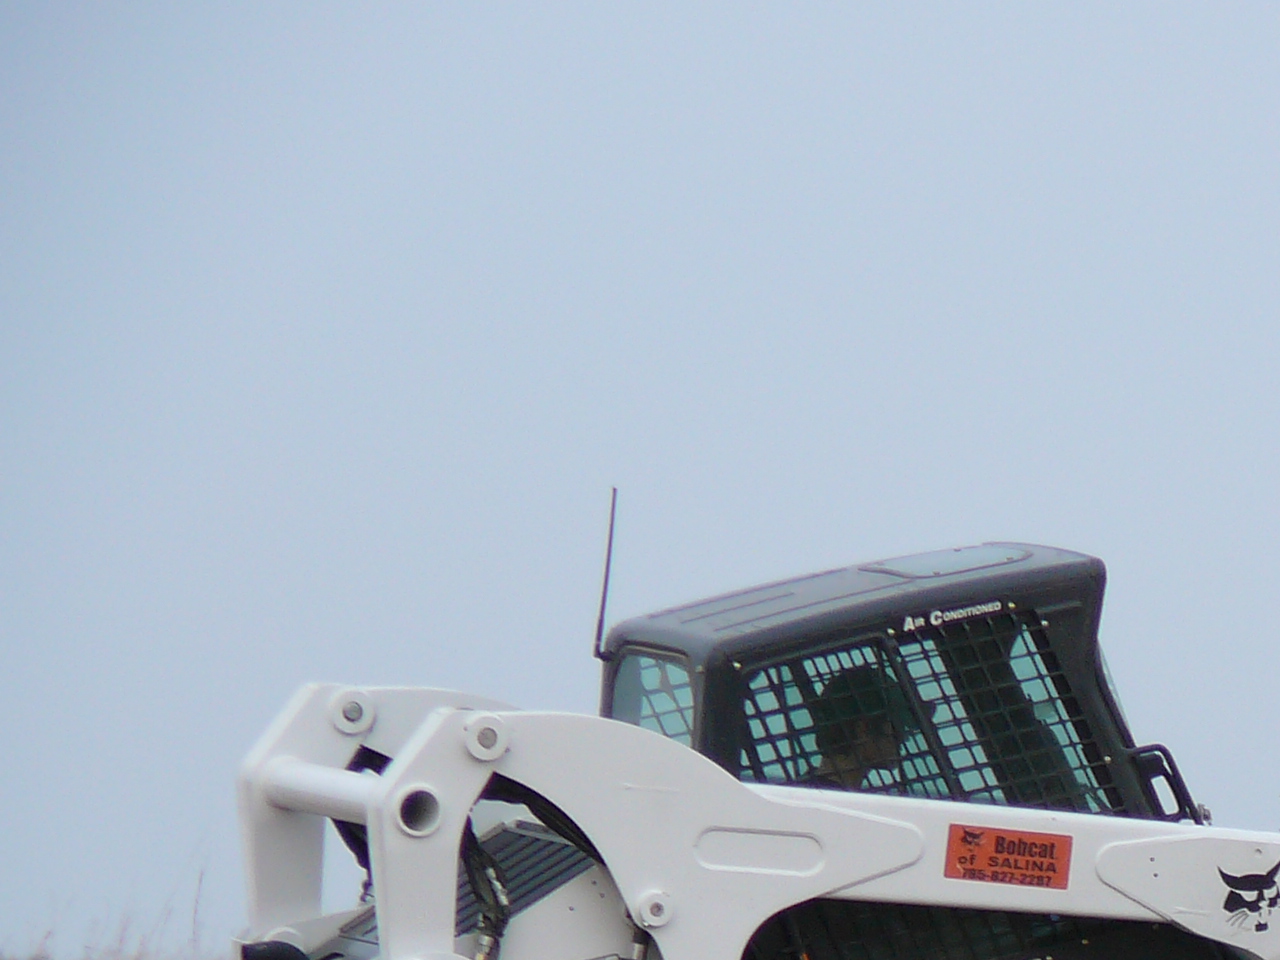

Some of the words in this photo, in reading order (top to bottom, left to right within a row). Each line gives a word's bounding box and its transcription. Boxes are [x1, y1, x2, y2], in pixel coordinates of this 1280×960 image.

[994, 835, 1057, 860] Bobcat
[957, 854, 977, 866] of
[987, 856, 1058, 874] SALINA
